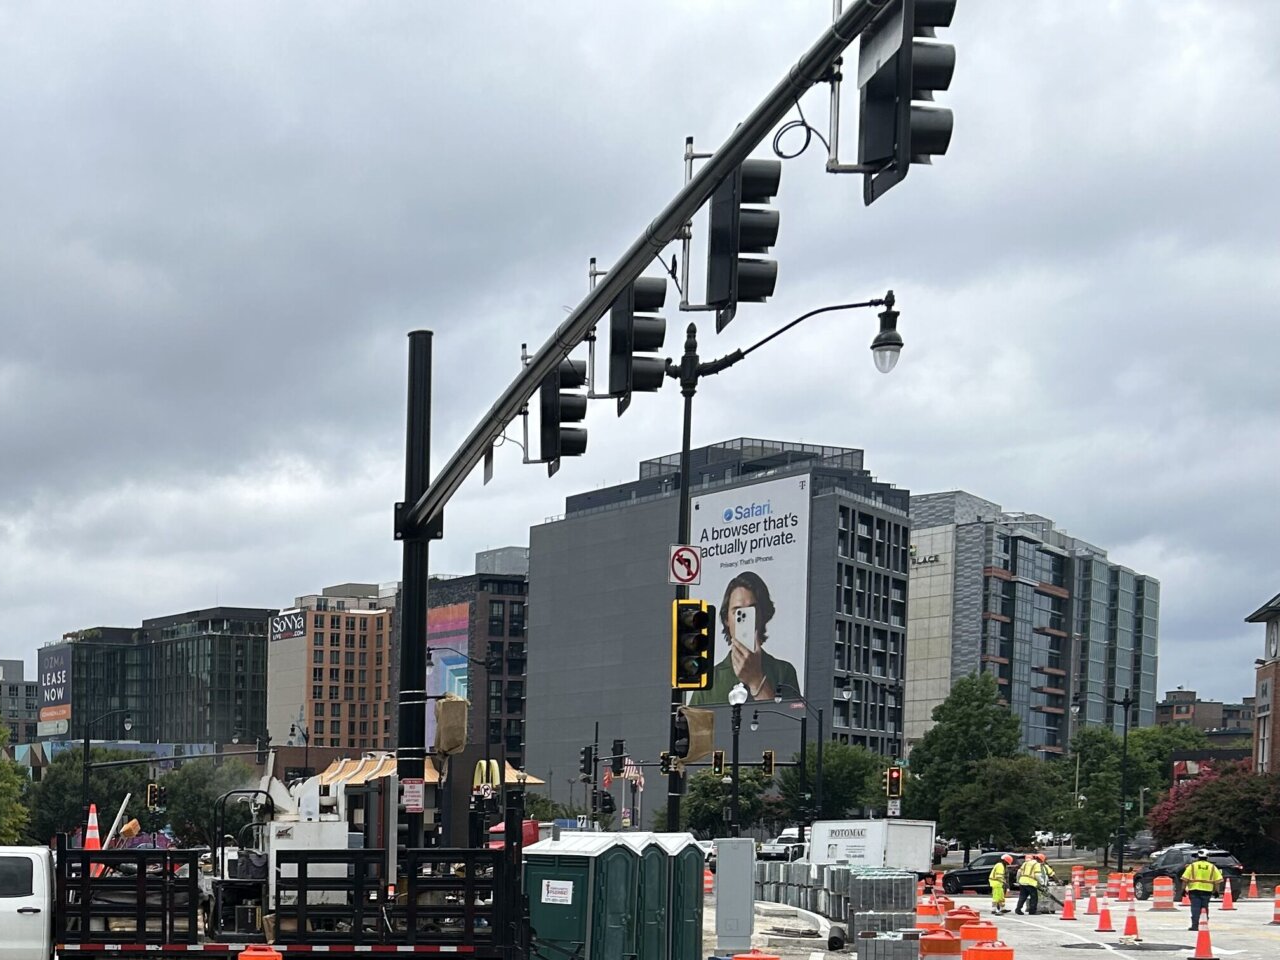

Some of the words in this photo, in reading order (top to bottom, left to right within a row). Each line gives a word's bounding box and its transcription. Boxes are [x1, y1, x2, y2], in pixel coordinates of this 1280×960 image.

[734, 499, 773, 520] Safari.
[700, 528, 709, 543] A
[711, 521, 761, 541] browser
[764, 513, 798, 531] that's
[701, 536, 747, 558] actually
[750, 532, 796, 553] private.
[42, 670, 66, 687] LEASE
[44, 688, 64, 702] NOW
[830, 828, 866, 838] POTOMAC
